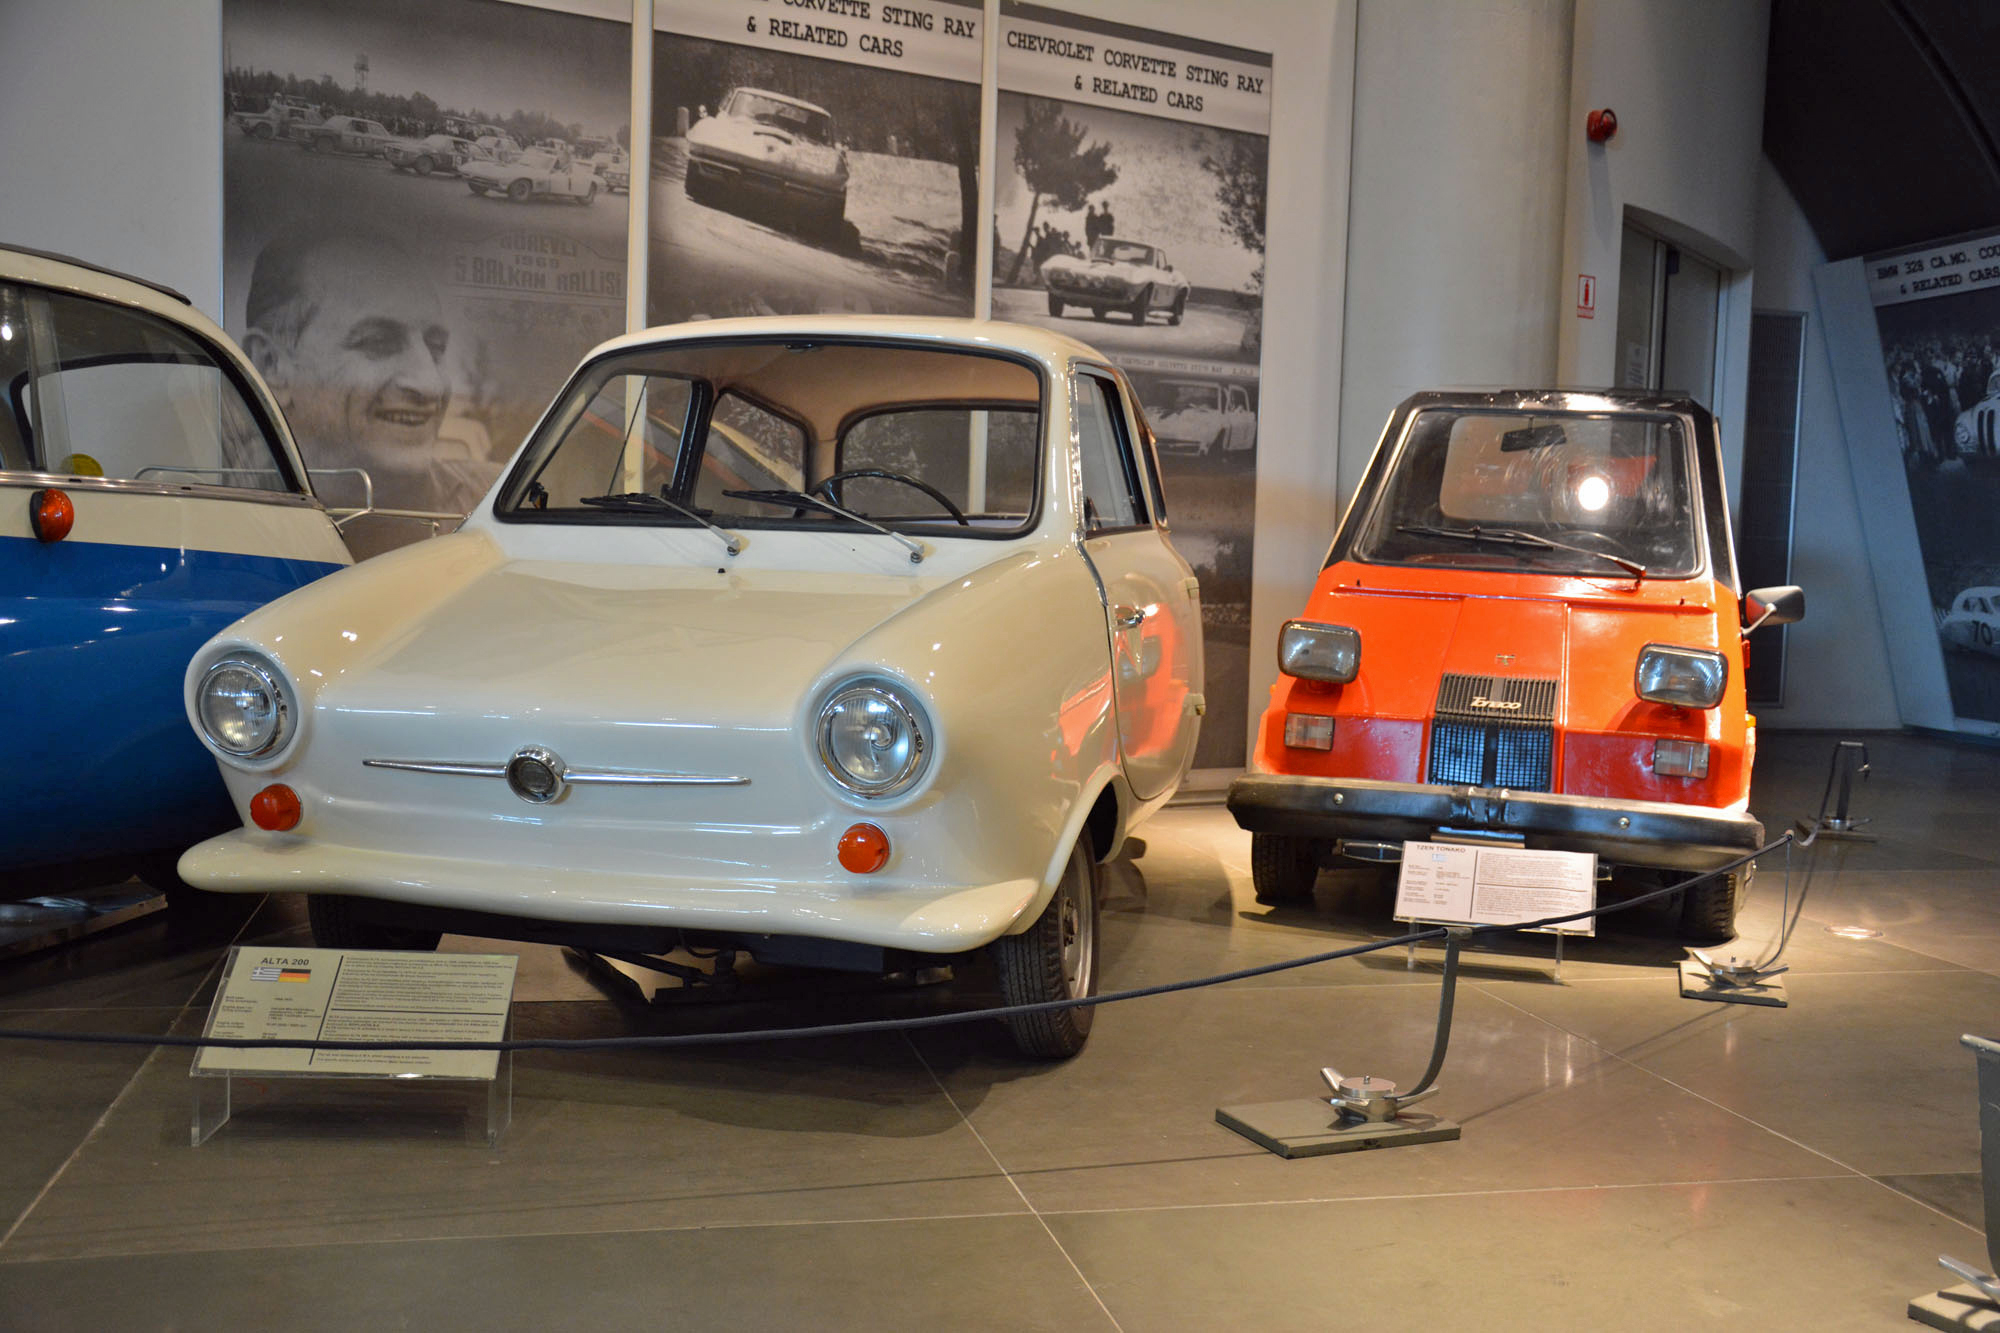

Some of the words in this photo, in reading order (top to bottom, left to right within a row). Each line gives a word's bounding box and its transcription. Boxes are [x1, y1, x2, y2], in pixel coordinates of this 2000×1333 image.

[747, 16, 757, 32] &
[769, 18, 848, 47] RELATED
[860, 34, 904, 58] CARS
[881, 6, 934, 31] STING
[944, 17, 976, 39] RAY
[1007, 30, 1094, 62] CHEVROLET
[1104, 49, 1176, 78] CORVETTE
[1186, 65, 1229, 88] STING
[1237, 75, 1264, 95] RAY
[1074, 75, 1083, 91] &
[1093, 77, 1158, 103] RELATED
[1167, 91, 1204, 111] CARS
[1912, 273, 1962, 292] RELATED
[1969, 265, 2000, 283] CARS
[261, 957, 289, 966] ALTA
[291, 958, 310, 967] 200
